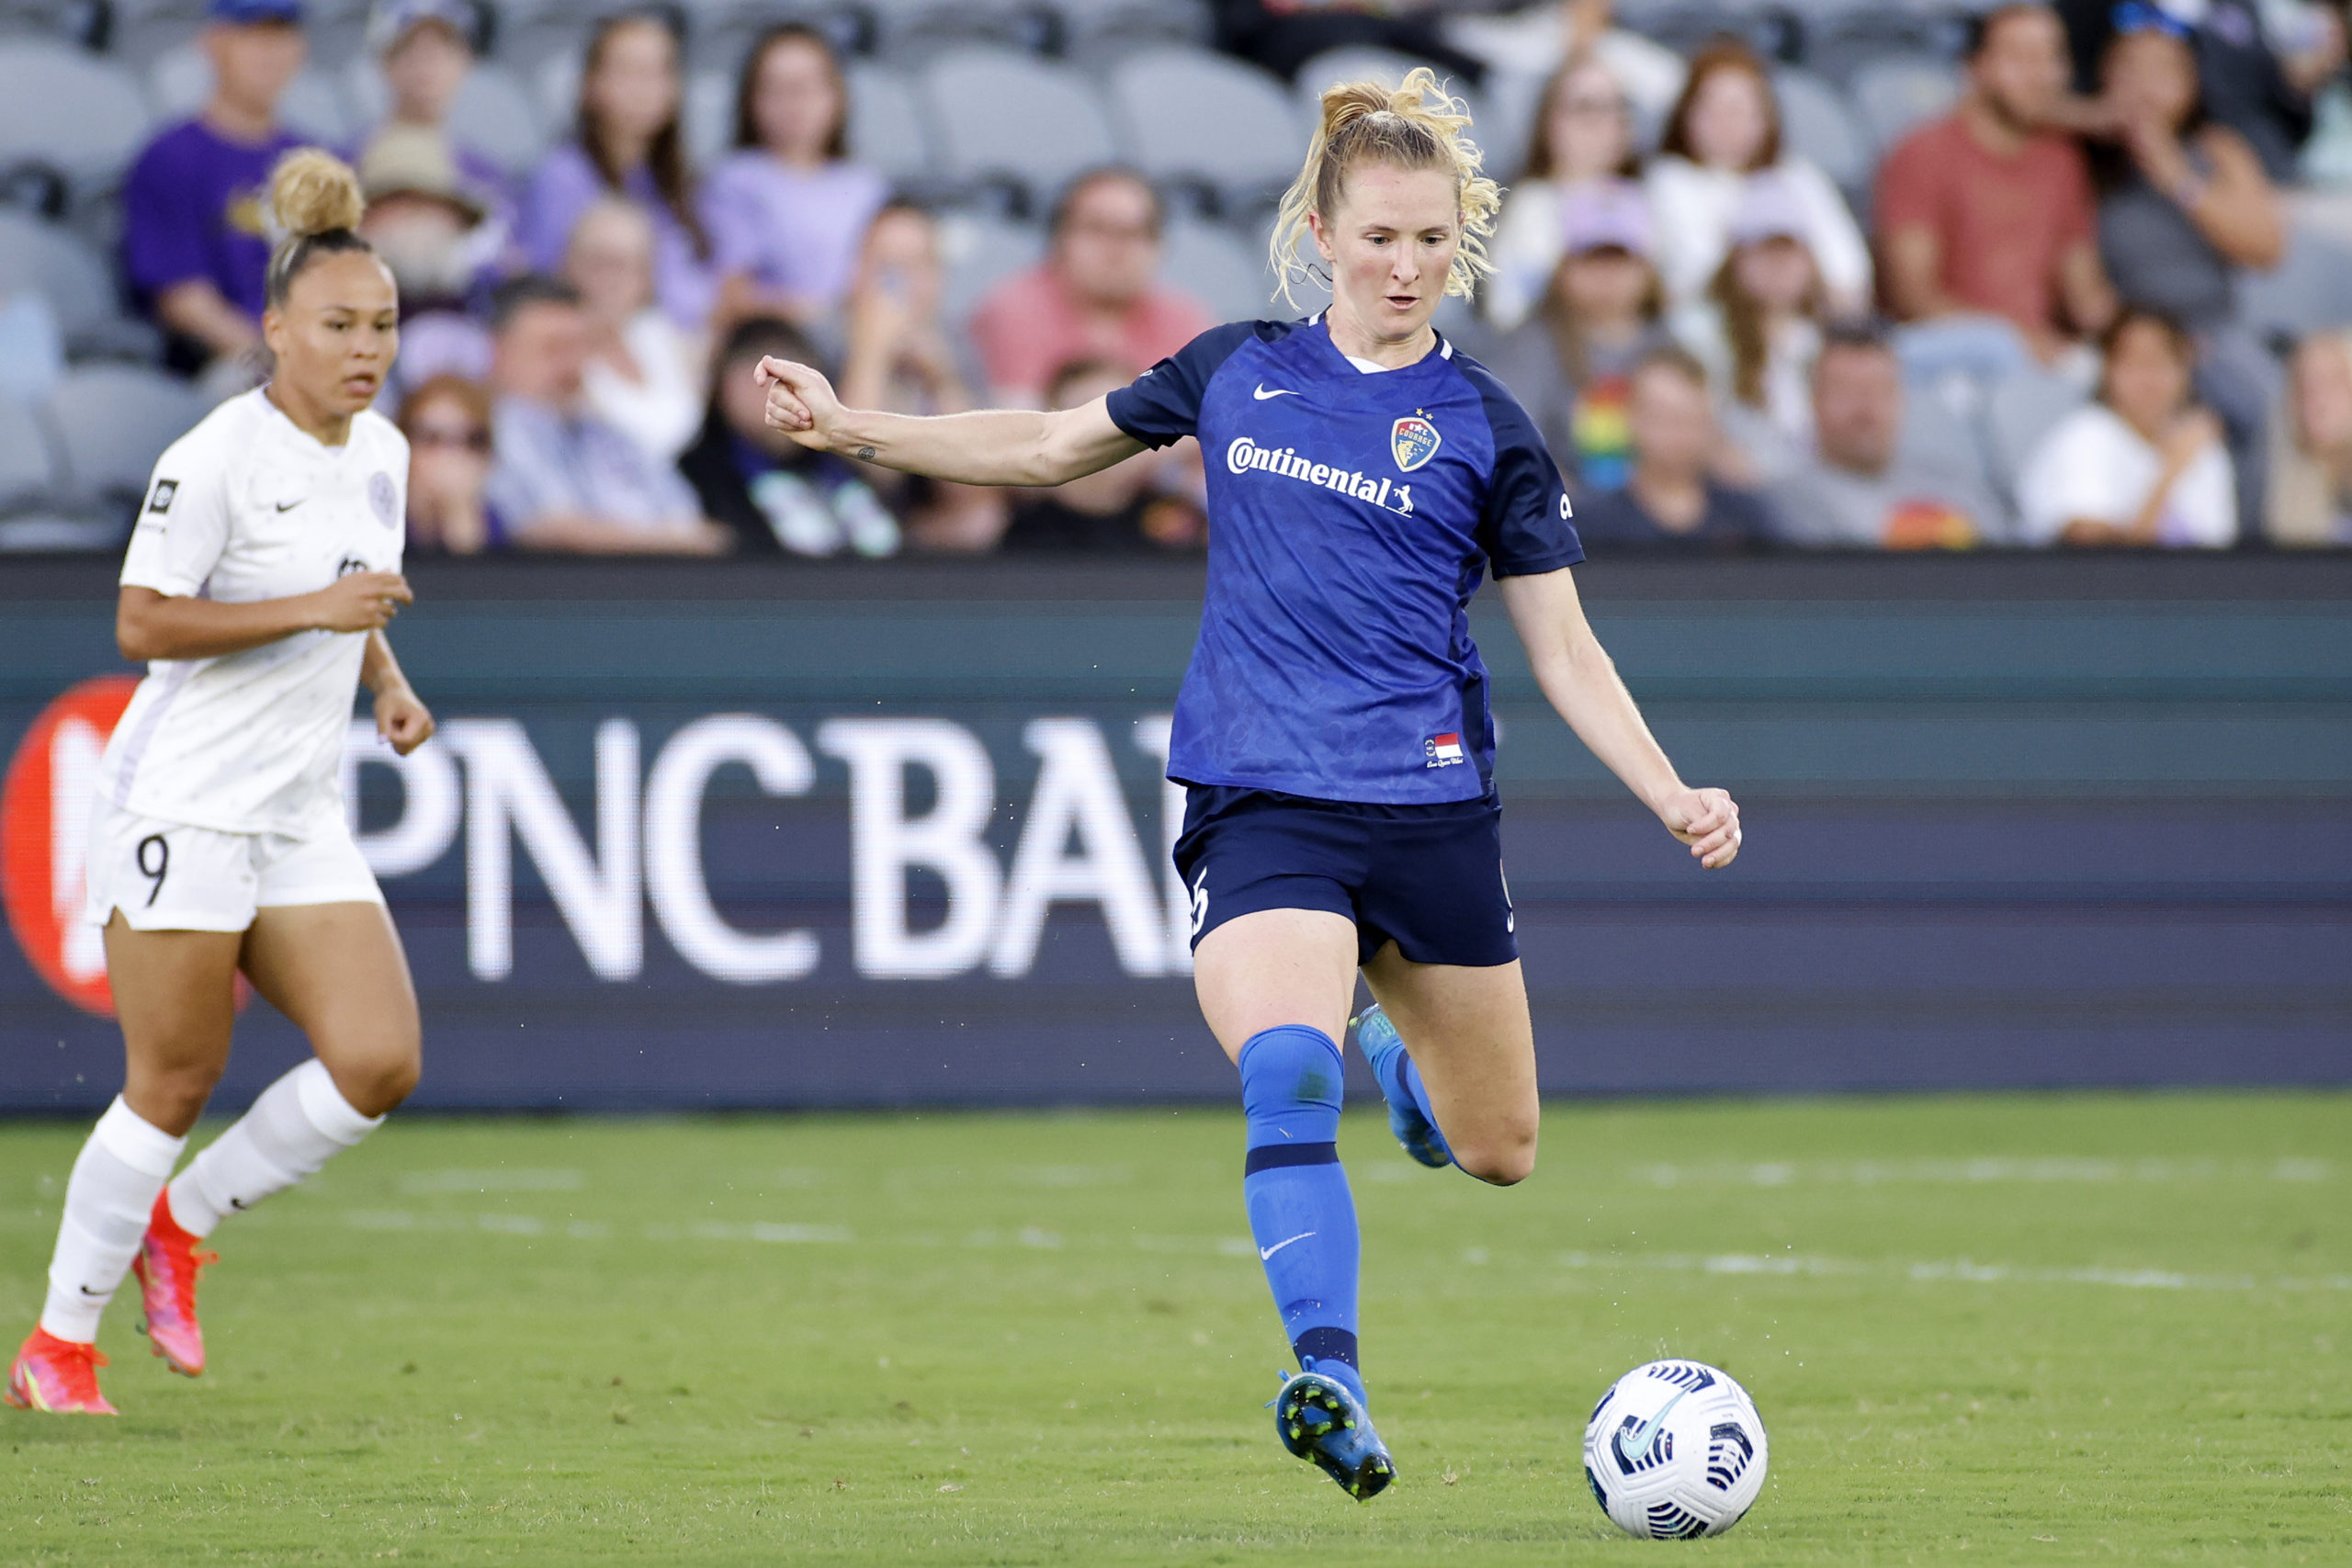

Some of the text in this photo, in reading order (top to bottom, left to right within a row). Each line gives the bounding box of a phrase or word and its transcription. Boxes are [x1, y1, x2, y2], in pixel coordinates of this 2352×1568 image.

[1227, 436, 1392, 508] Continental
[1399, 427, 1433, 447] COURAGE
[137, 833, 169, 908] 9
